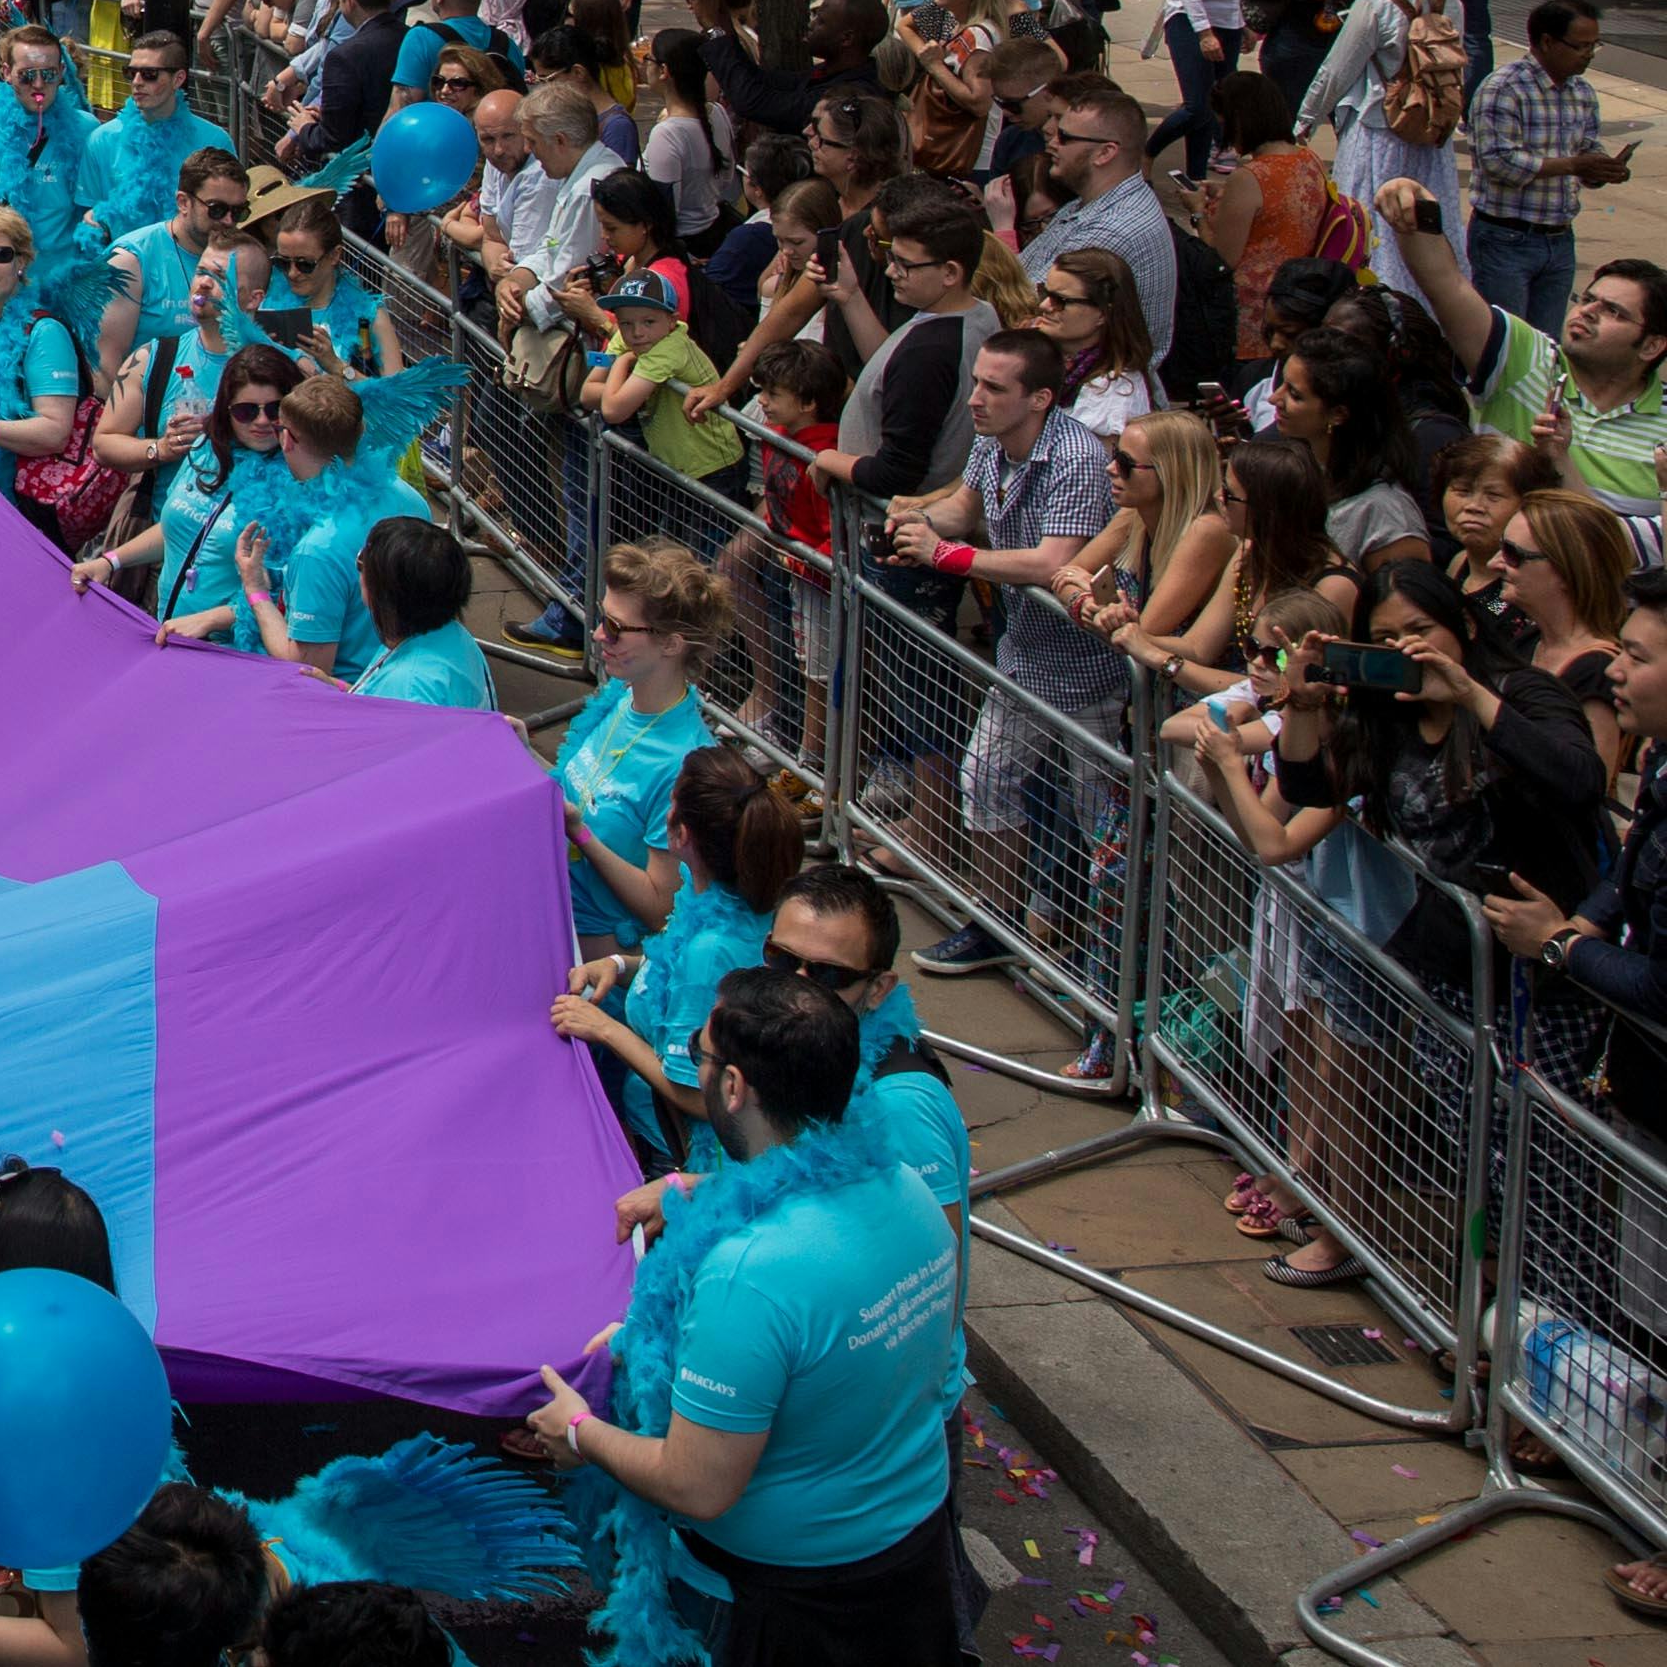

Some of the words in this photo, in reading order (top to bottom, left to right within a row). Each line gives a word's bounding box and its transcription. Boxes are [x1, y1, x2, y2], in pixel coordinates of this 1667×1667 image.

[858, 1288, 897, 1323] Support
[896, 1272, 920, 1297] Pride
[918, 1266, 929, 1280] in
[847, 1320, 888, 1351] Donate
[888, 1313, 898, 1326] to
[884, 1334, 898, 1351] via
[898, 1309, 931, 1341] Barclays
[686, 1368, 738, 1399] BARCLAYS
